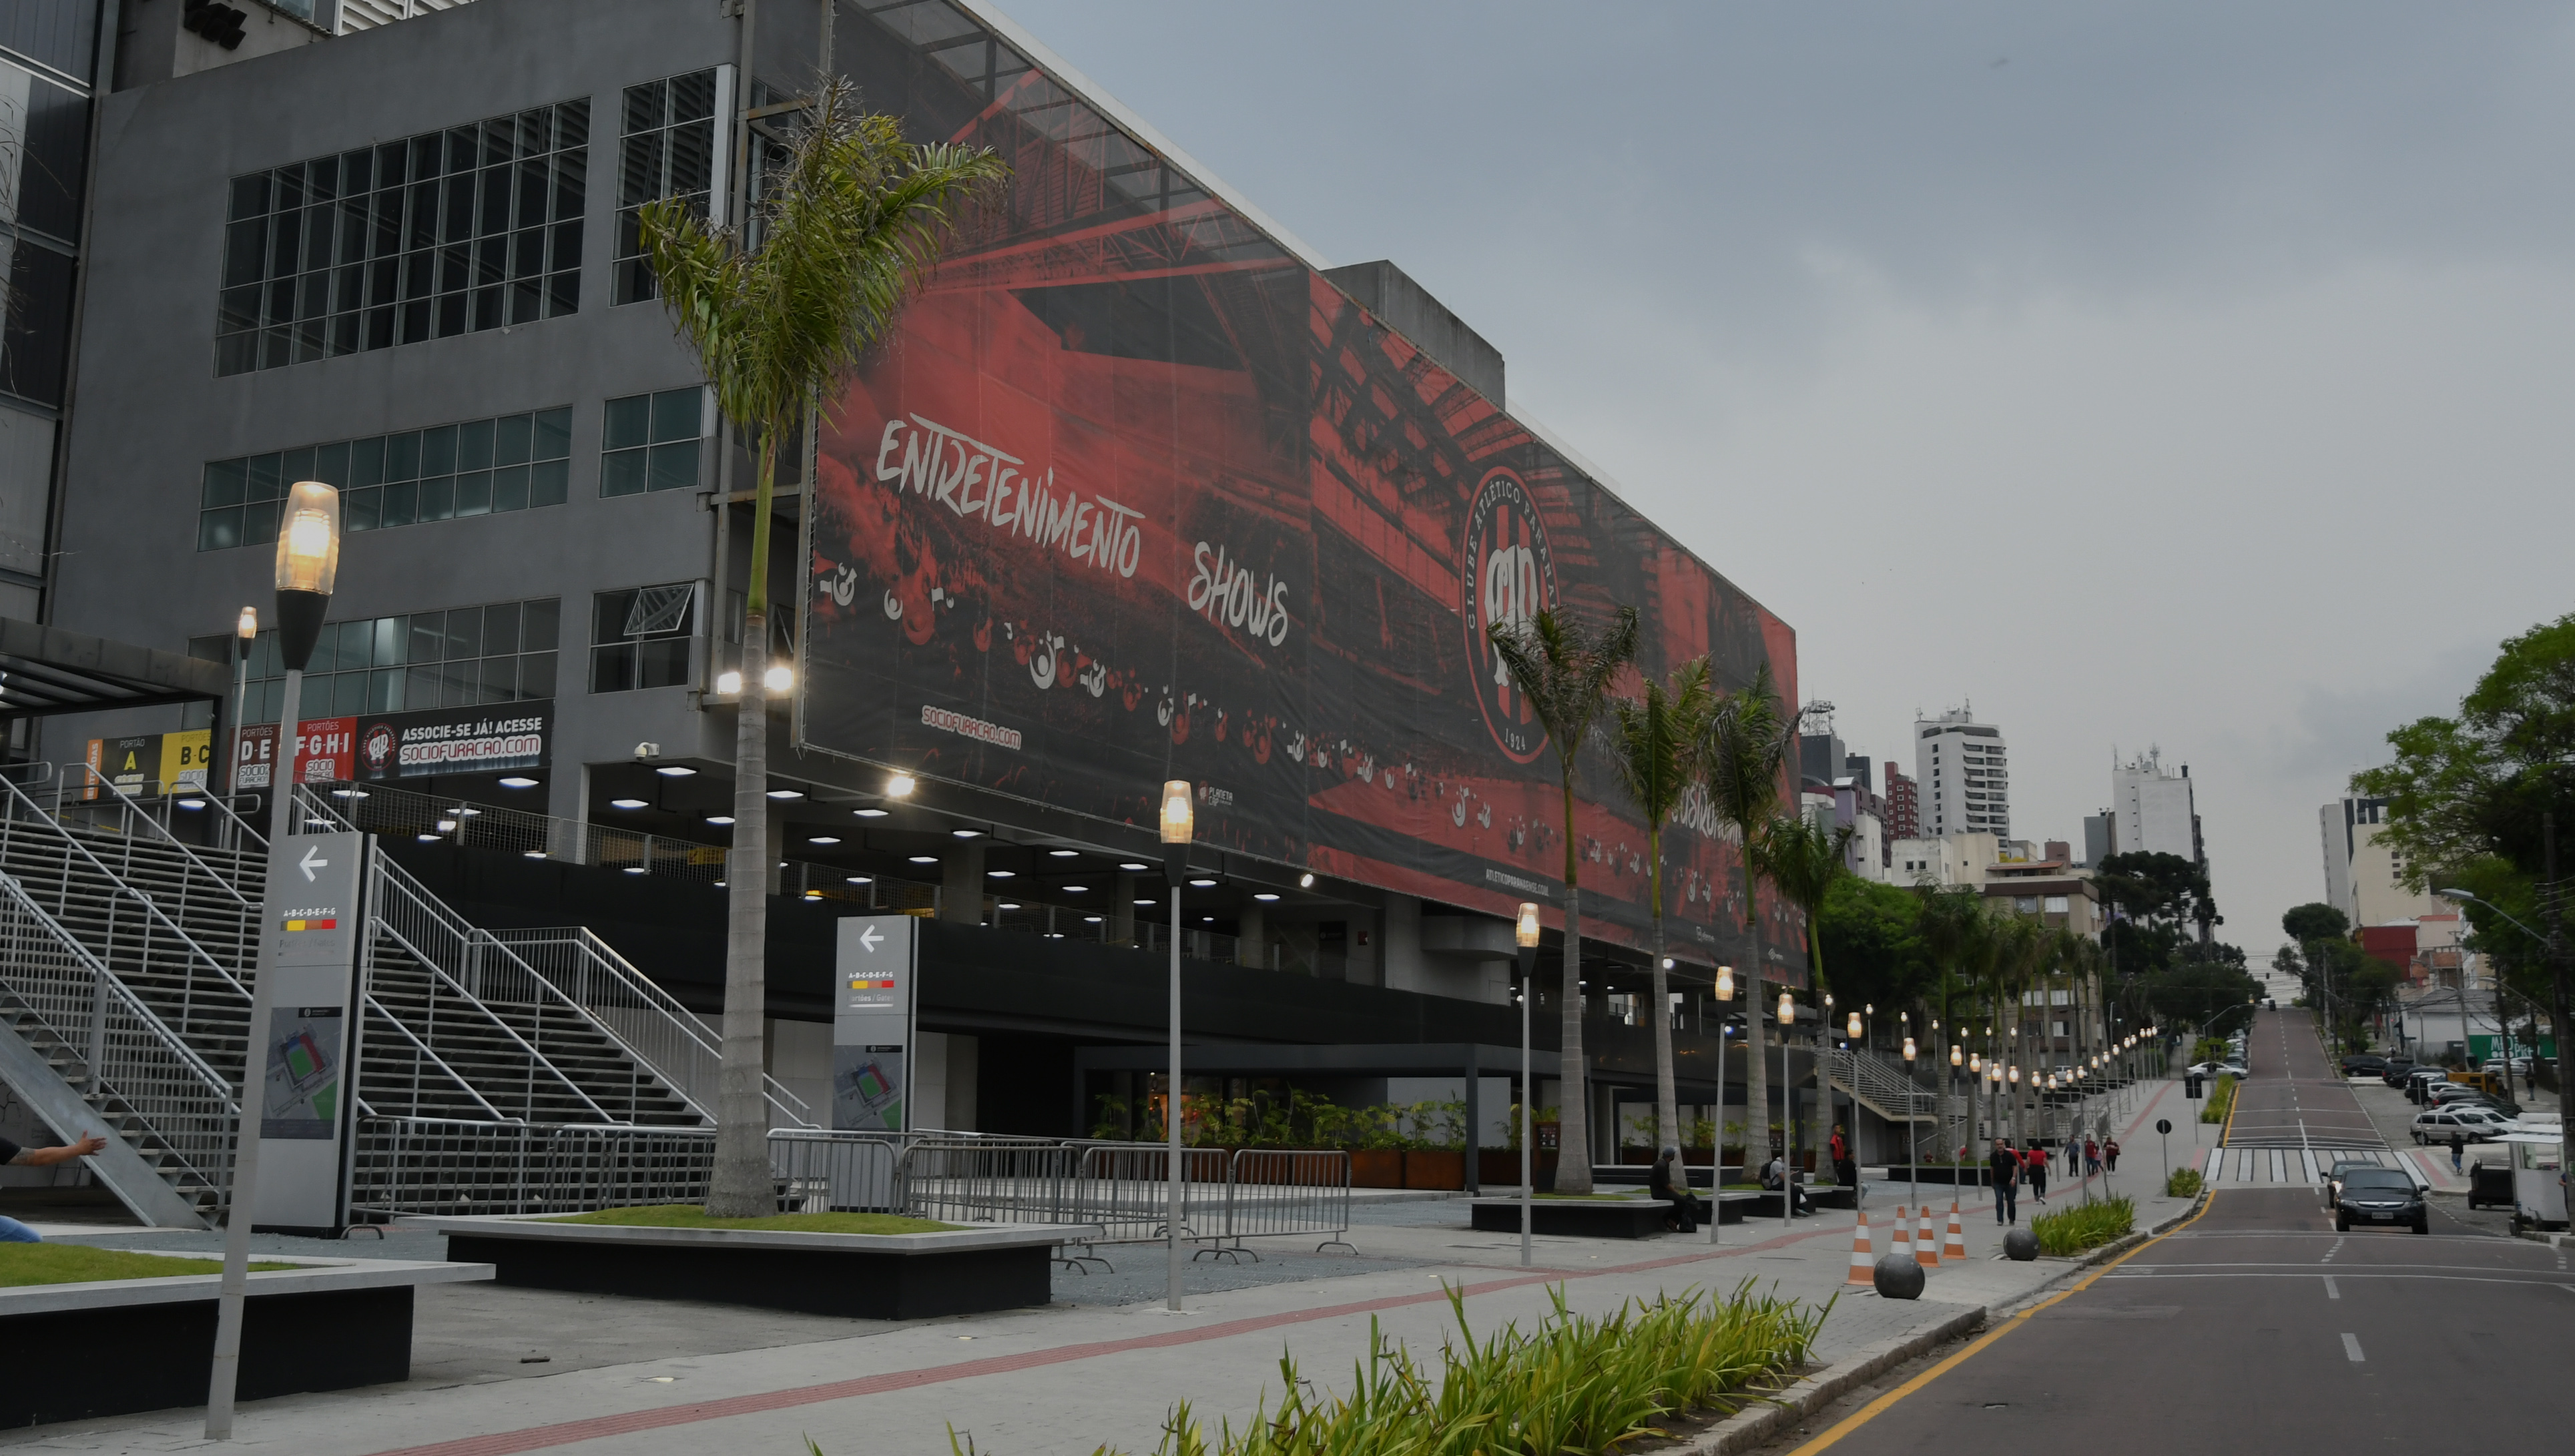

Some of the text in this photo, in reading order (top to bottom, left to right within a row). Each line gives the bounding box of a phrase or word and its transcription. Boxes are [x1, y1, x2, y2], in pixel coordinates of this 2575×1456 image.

[876, 412, 1145, 578] ENTRETENIMENTO
[1466, 535, 1477, 629] CLUBE
[1474, 480, 1520, 530] ATLÉTICO
[1188, 541, 1288, 647] SHOWS
[242, 727, 273, 737] PORTÕES
[307, 721, 339, 732] PORTÕES
[402, 717, 542, 741] ASSOCIE-SE JÁ! ACESSE
[119, 737, 146, 749] PORTÃO
[1505, 728, 1526, 751] 1924
[123, 751, 137, 771] A
[283, 907, 336, 917] A-B-C-D-E-F-G
